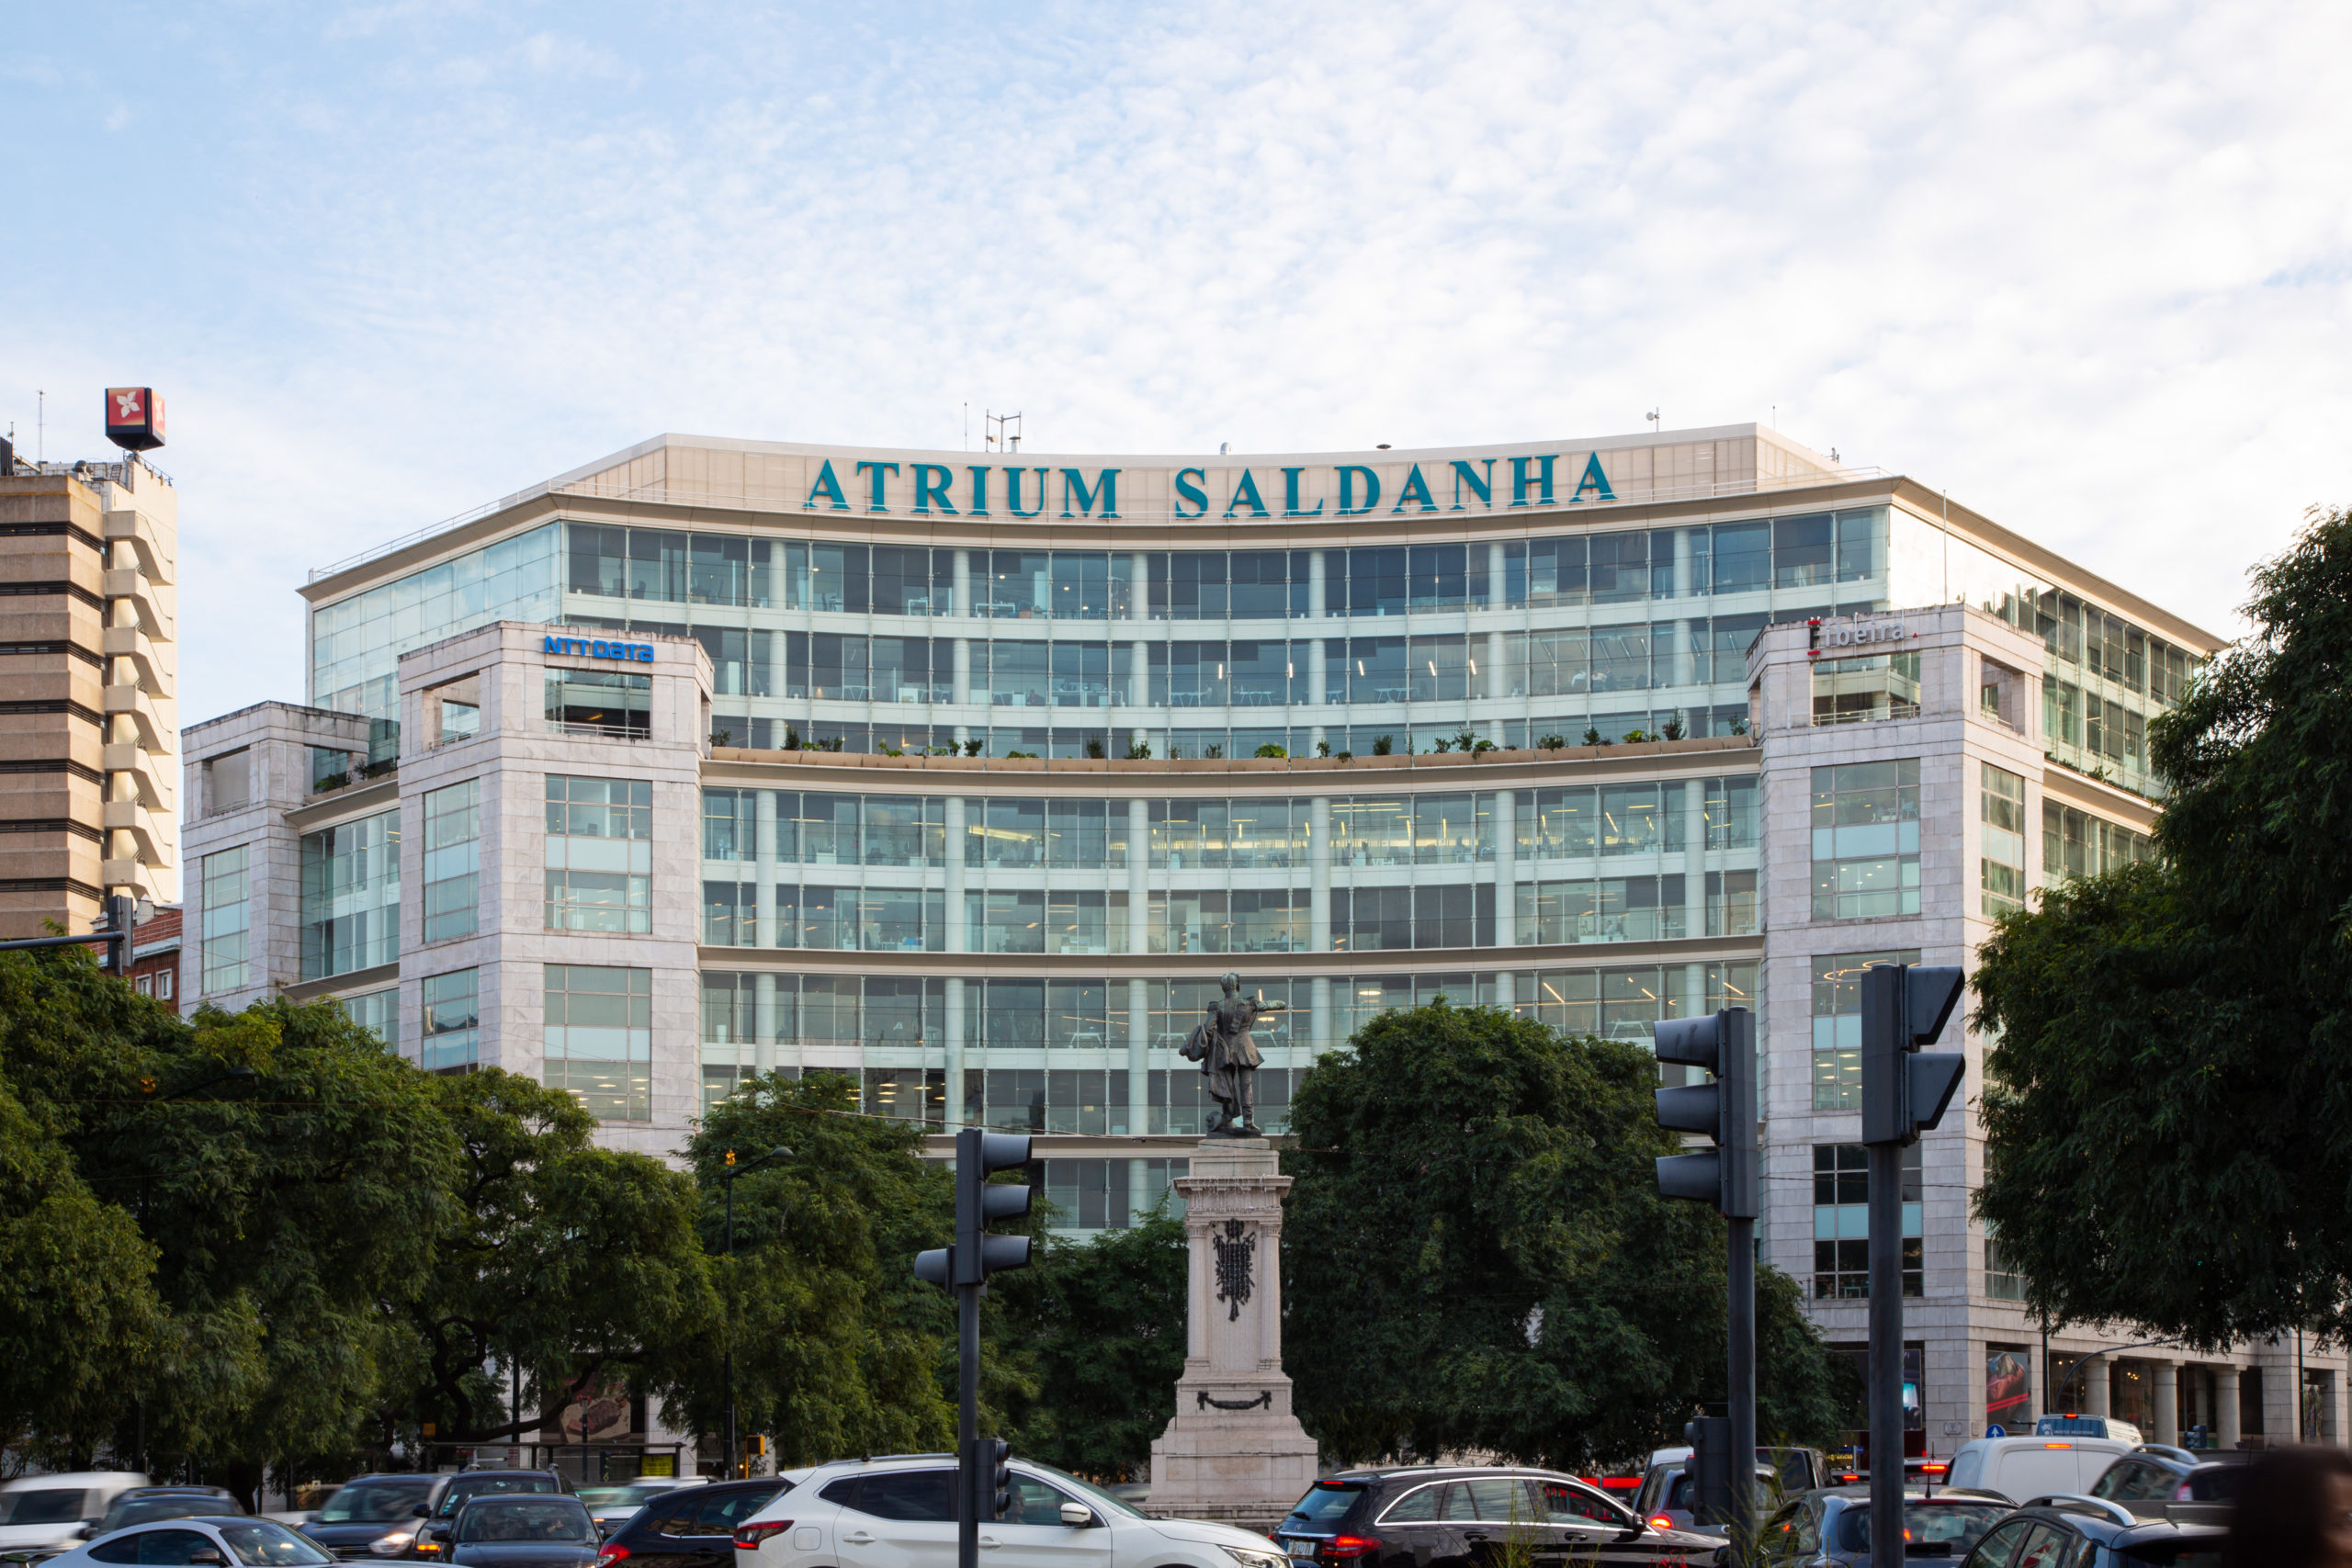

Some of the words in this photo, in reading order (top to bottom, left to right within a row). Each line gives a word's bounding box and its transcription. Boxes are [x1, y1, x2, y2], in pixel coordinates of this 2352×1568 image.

[802, 457, 1123, 518] ATRIUM
[1175, 450, 1618, 520] SALDANHA
[544, 636, 591, 657] NTT
